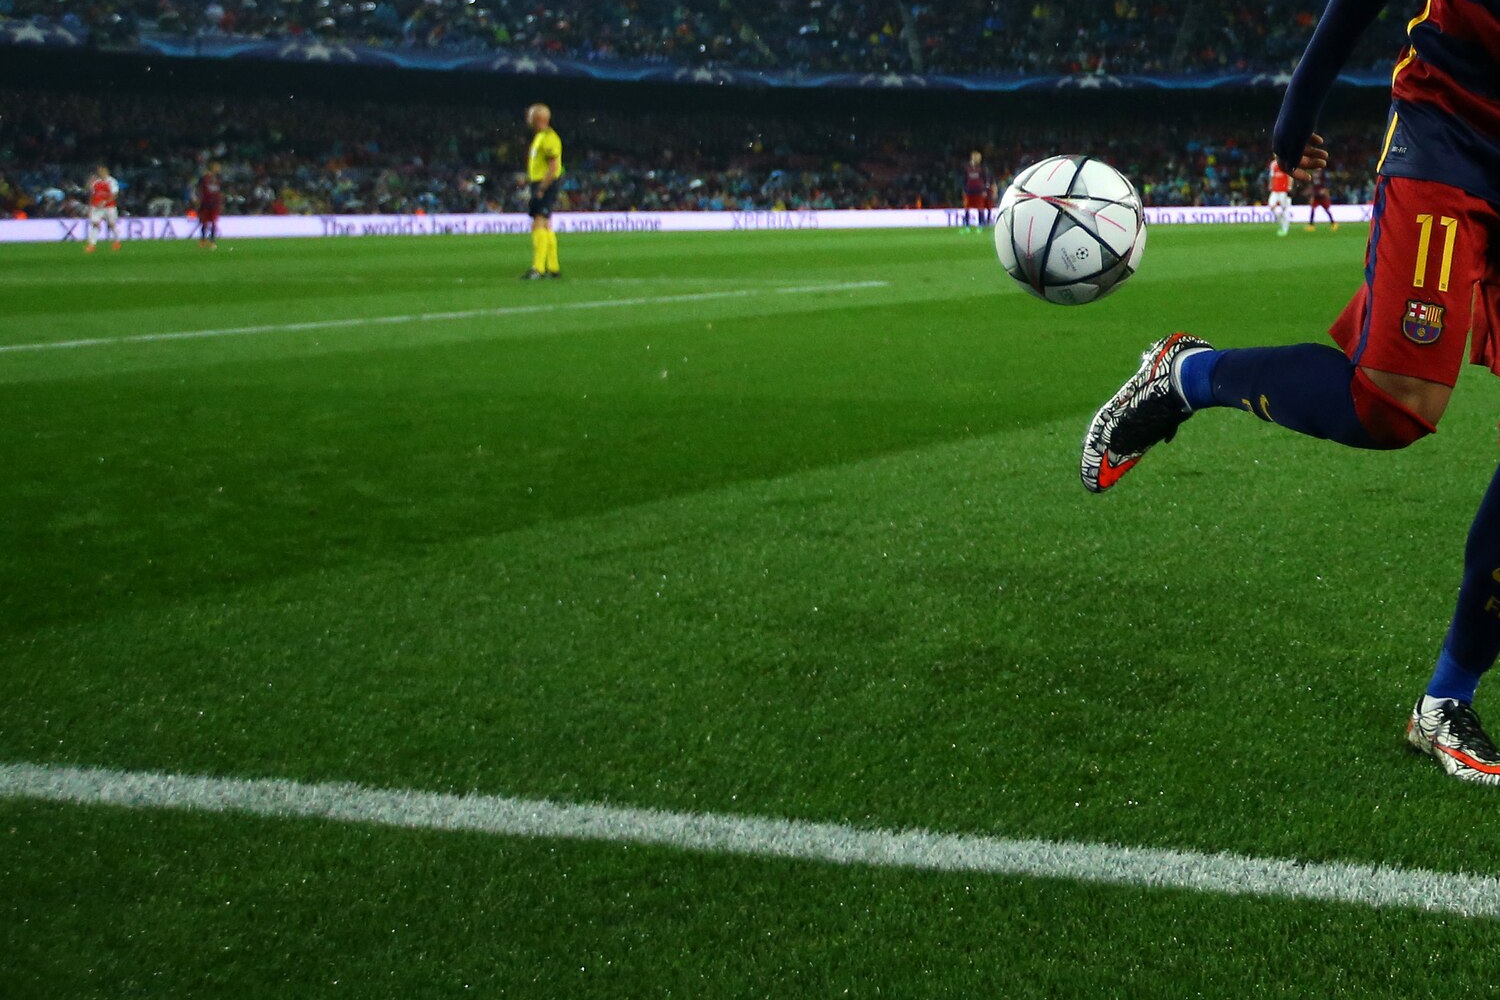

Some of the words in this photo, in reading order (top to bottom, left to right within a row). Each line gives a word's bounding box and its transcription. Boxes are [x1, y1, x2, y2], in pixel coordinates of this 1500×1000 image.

[320, 215, 356, 236] The
[363, 215, 427, 236] world's
[432, 214, 467, 235] best
[571, 211, 662, 233] smartphone
[732, 211, 794, 230] XPERIA
[1156, 207, 1172, 223] in
[1176, 211, 1186, 223] a
[1192, 207, 1294, 224] smartpho
[58, 218, 177, 241] XRIA
[1412, 213, 1458, 292] 11
